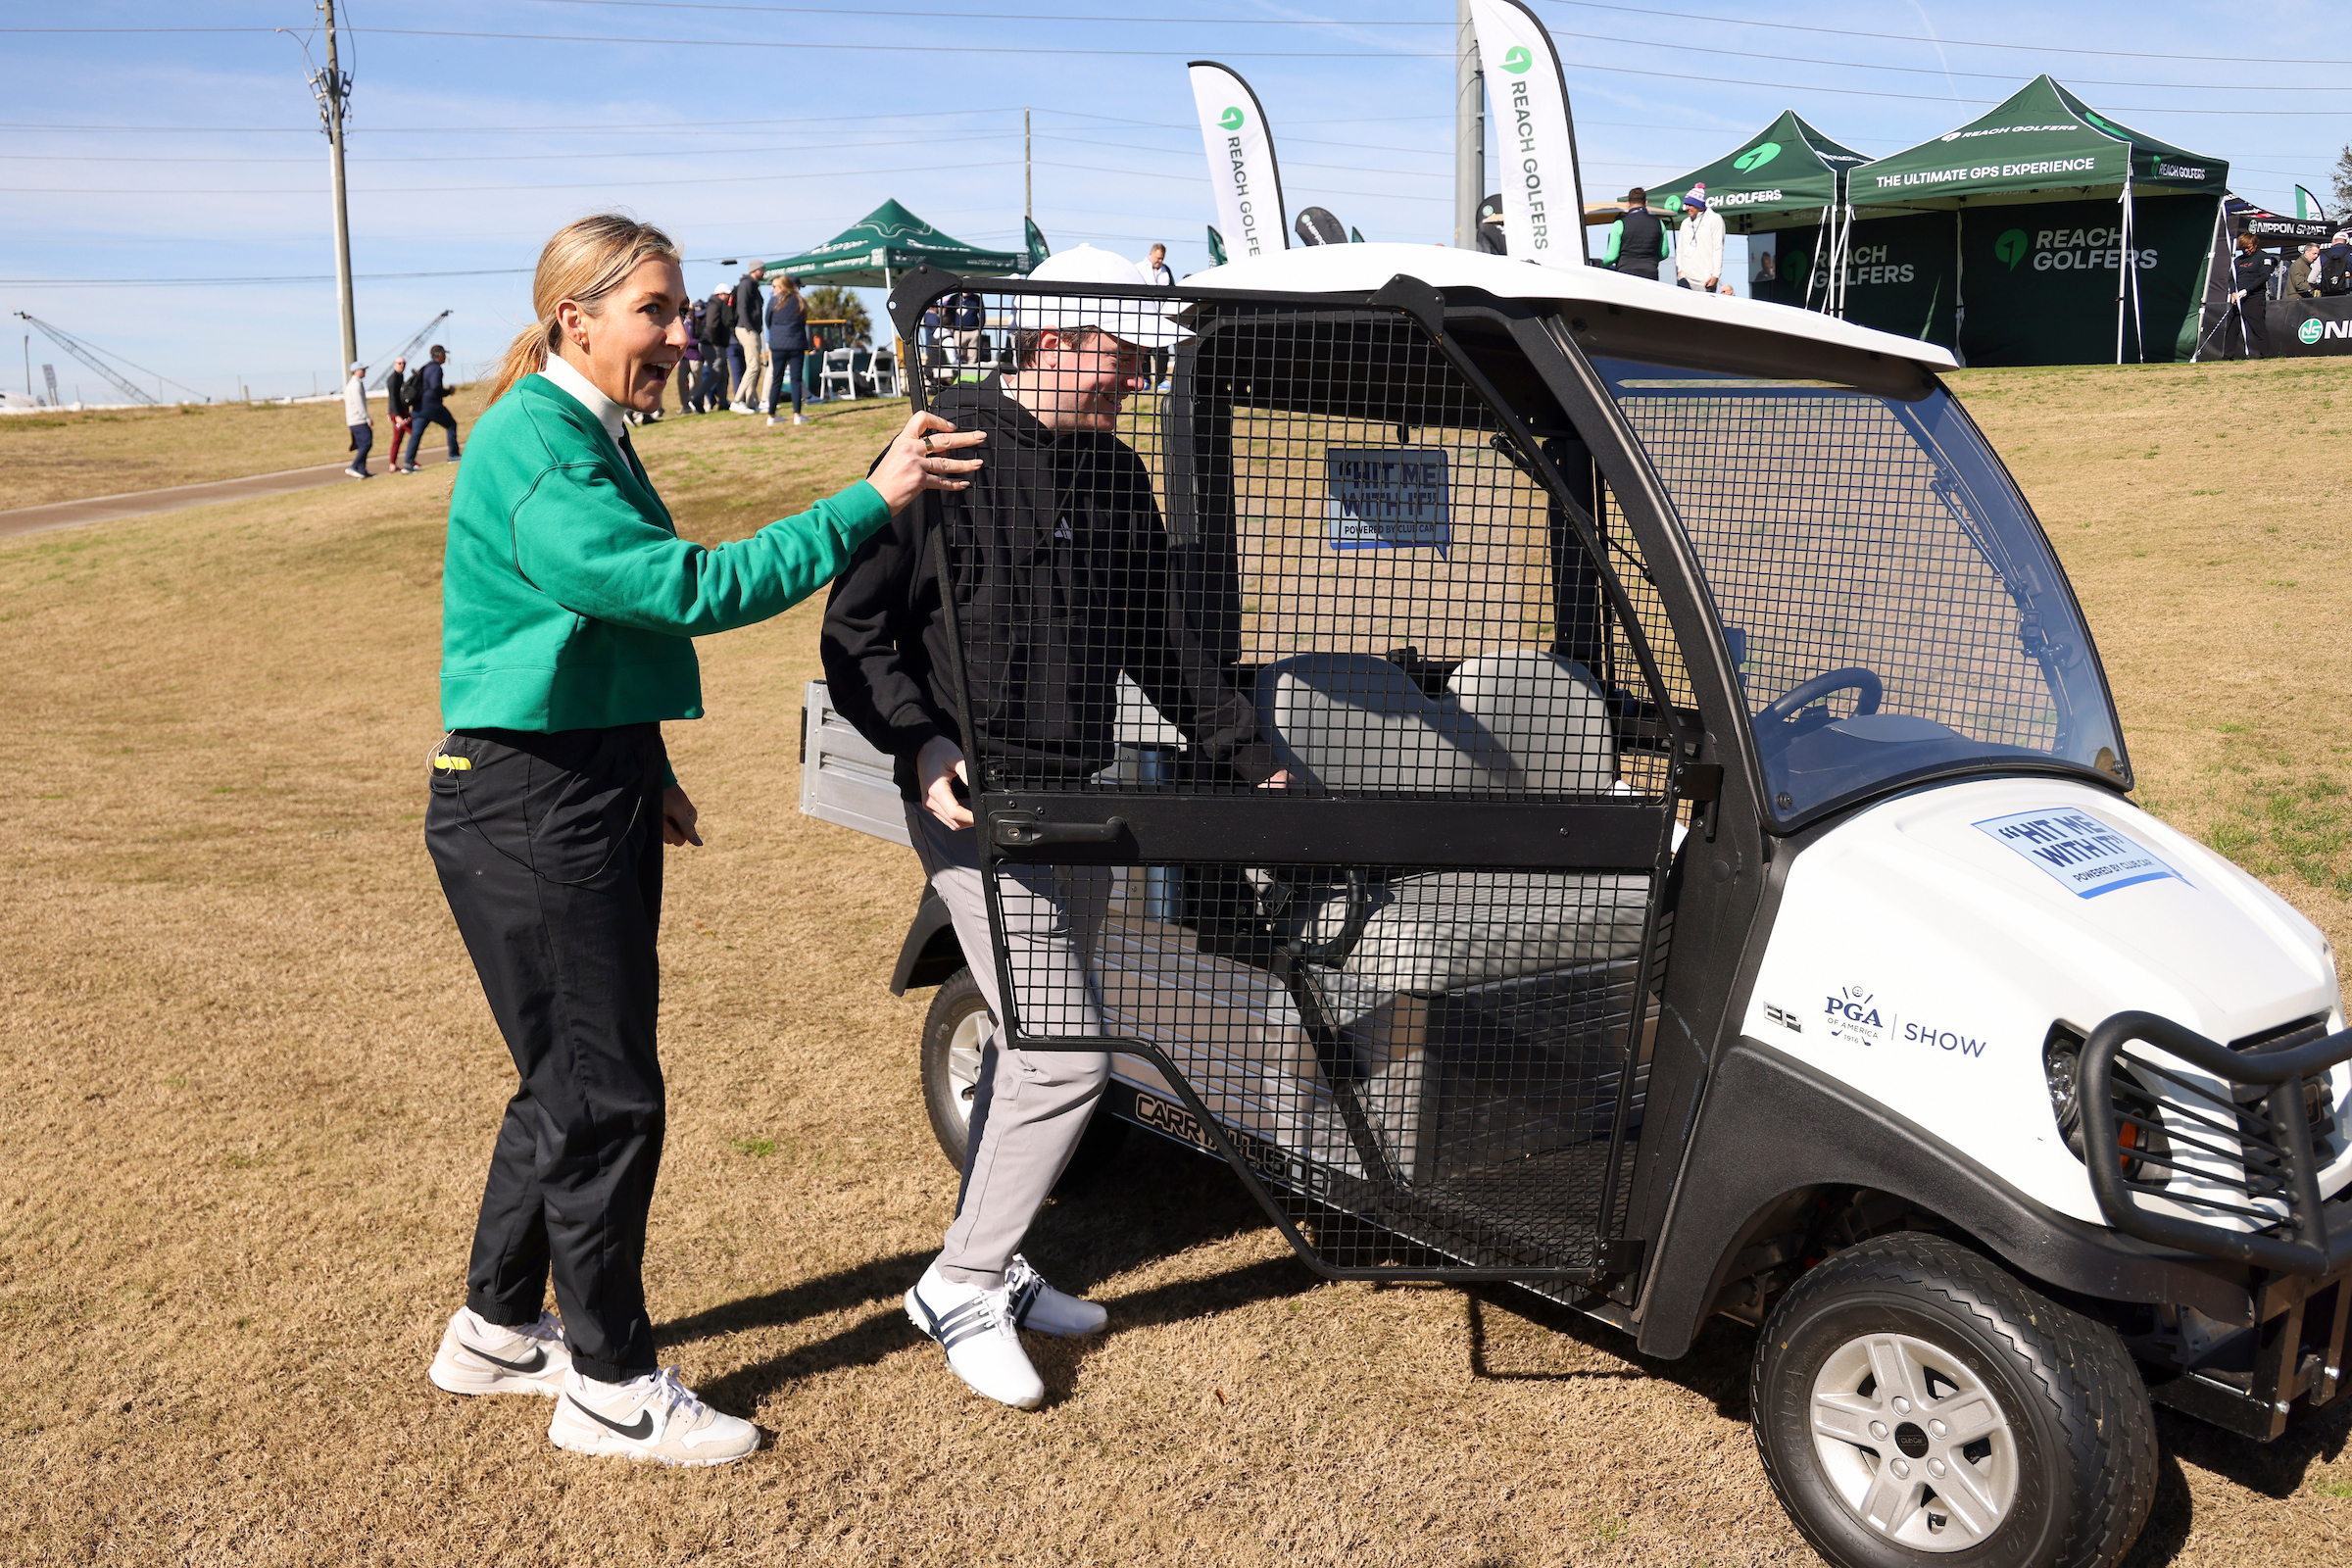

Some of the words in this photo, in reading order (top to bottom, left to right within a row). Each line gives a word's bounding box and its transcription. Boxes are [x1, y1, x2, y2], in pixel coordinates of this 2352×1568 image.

[1511, 80, 1537, 153] REACH
[1961, 126, 2010, 139] REACH
[1227, 135, 1250, 196] REACH
[1876, 173, 1901, 188] THE
[1903, 169, 1968, 185] ULTIMATE
[1970, 166, 2000, 179] GPS
[2002, 157, 2095, 177] EXPERIENCE
[2158, 163, 2180, 177] REACH
[2179, 168, 2206, 181] GOLFERS
[1522, 158, 1549, 250] GOLFERS
[1726, 189, 1783, 206] GOLFERS
[2035, 226, 2124, 249] REACH
[2256, 221, 2295, 235] NIPPON
[2296, 222, 2328, 236] SHAFT
[1402, 462, 1438, 489] ME
[1342, 492, 1400, 517] WITH
[1345, 525, 1385, 535] POWERED
[1386, 524, 1396, 534] BY
[1419, 524, 1436, 533] CAR
[2052, 814, 2107, 836] ME
[2032, 838, 2104, 868] WITH
[2072, 865, 2114, 883] POWERED
[2109, 862, 2126, 873] BY
[2119, 859, 2142, 871] CLUB
[2135, 858, 2155, 867] CAR
[1824, 996, 1884, 1028] PGA
[1904, 1022, 1986, 1058] SHOW
[1827, 1017, 1839, 1026] OF
[1840, 1021, 1879, 1039] AMERICA
[1842, 1034, 1859, 1045] 1916
